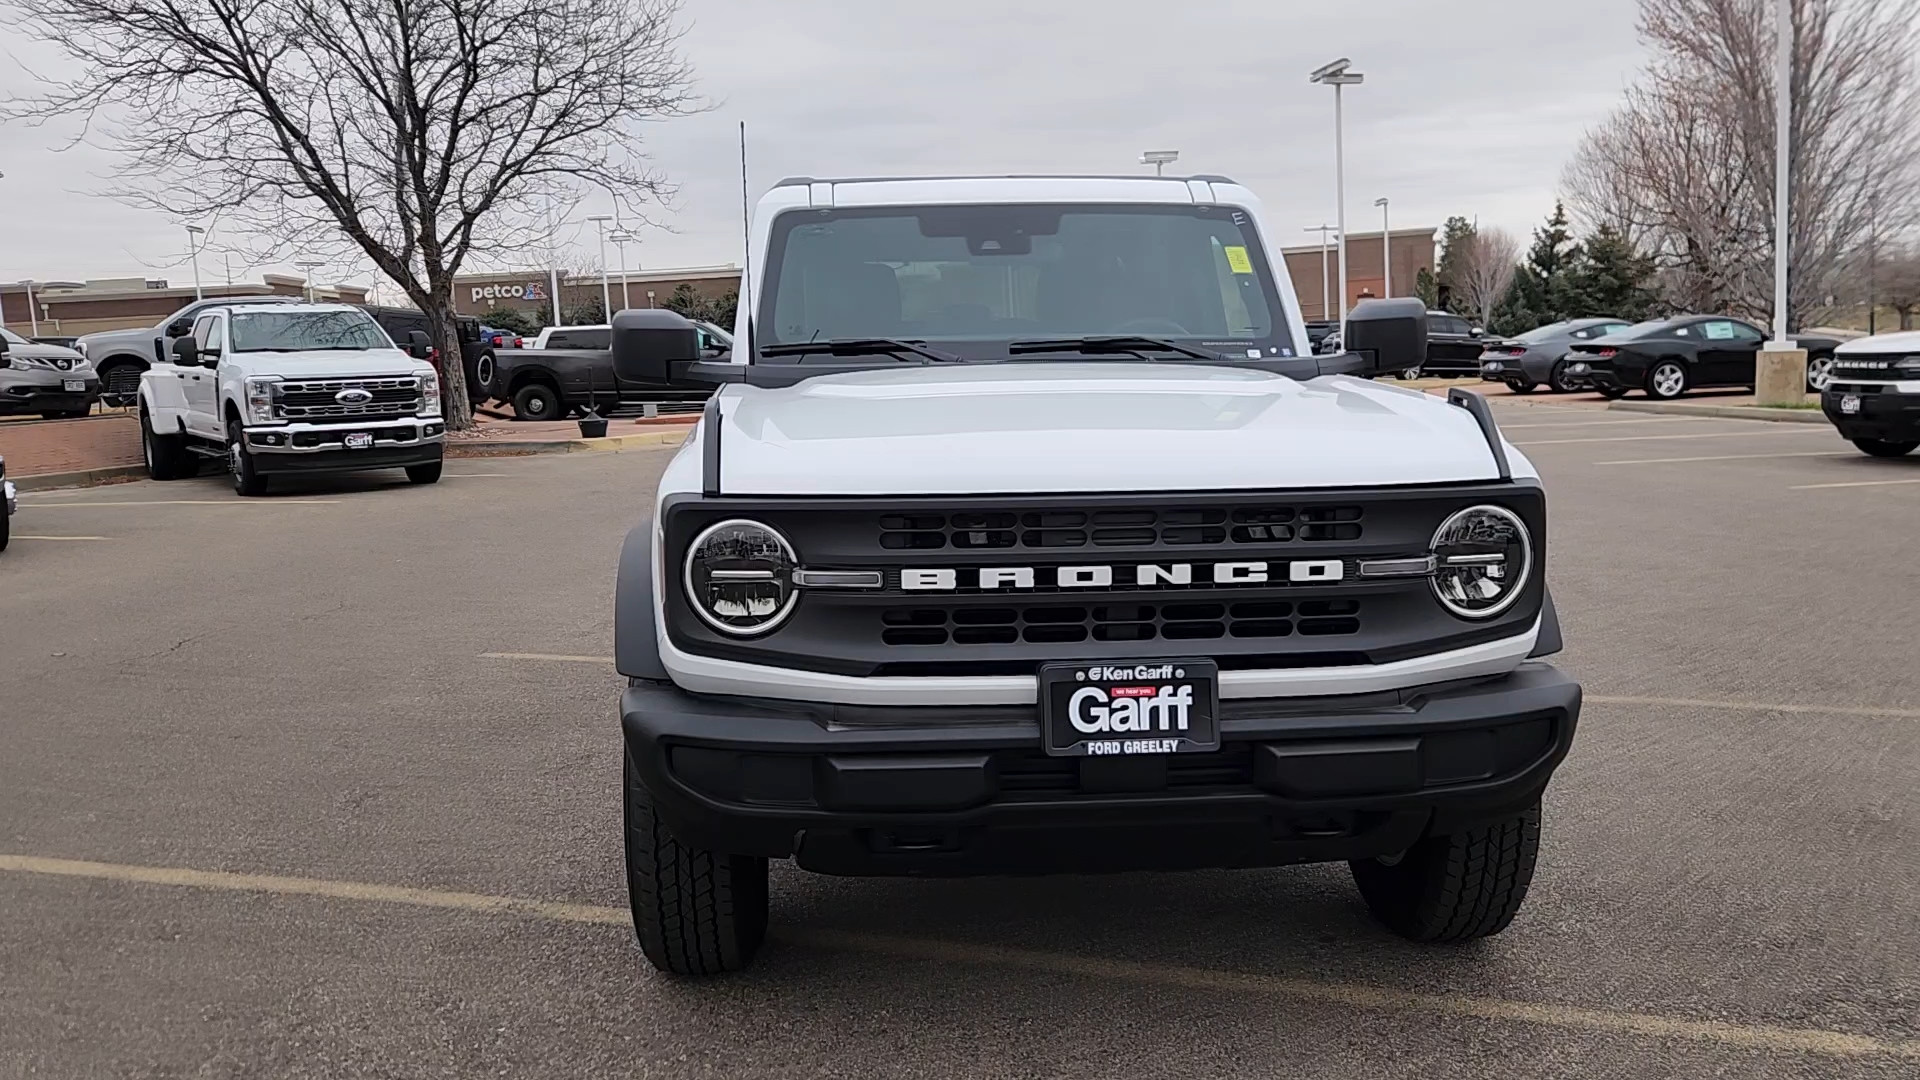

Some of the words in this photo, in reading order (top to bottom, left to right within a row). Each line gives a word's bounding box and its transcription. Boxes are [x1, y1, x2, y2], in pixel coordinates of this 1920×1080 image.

[471, 284, 524, 302] petco
[900, 559, 1345, 590] BRONCO
[1103, 666, 1133, 681] Ken
[1135, 665, 1173, 680] Garff
[1125, 687, 1139, 695] hear
[1139, 687, 1152, 696] you
[1068, 685, 1193, 734] Garff
[1088, 741, 1121, 755] FORD
[1123, 739, 1179, 754] GREELEY
